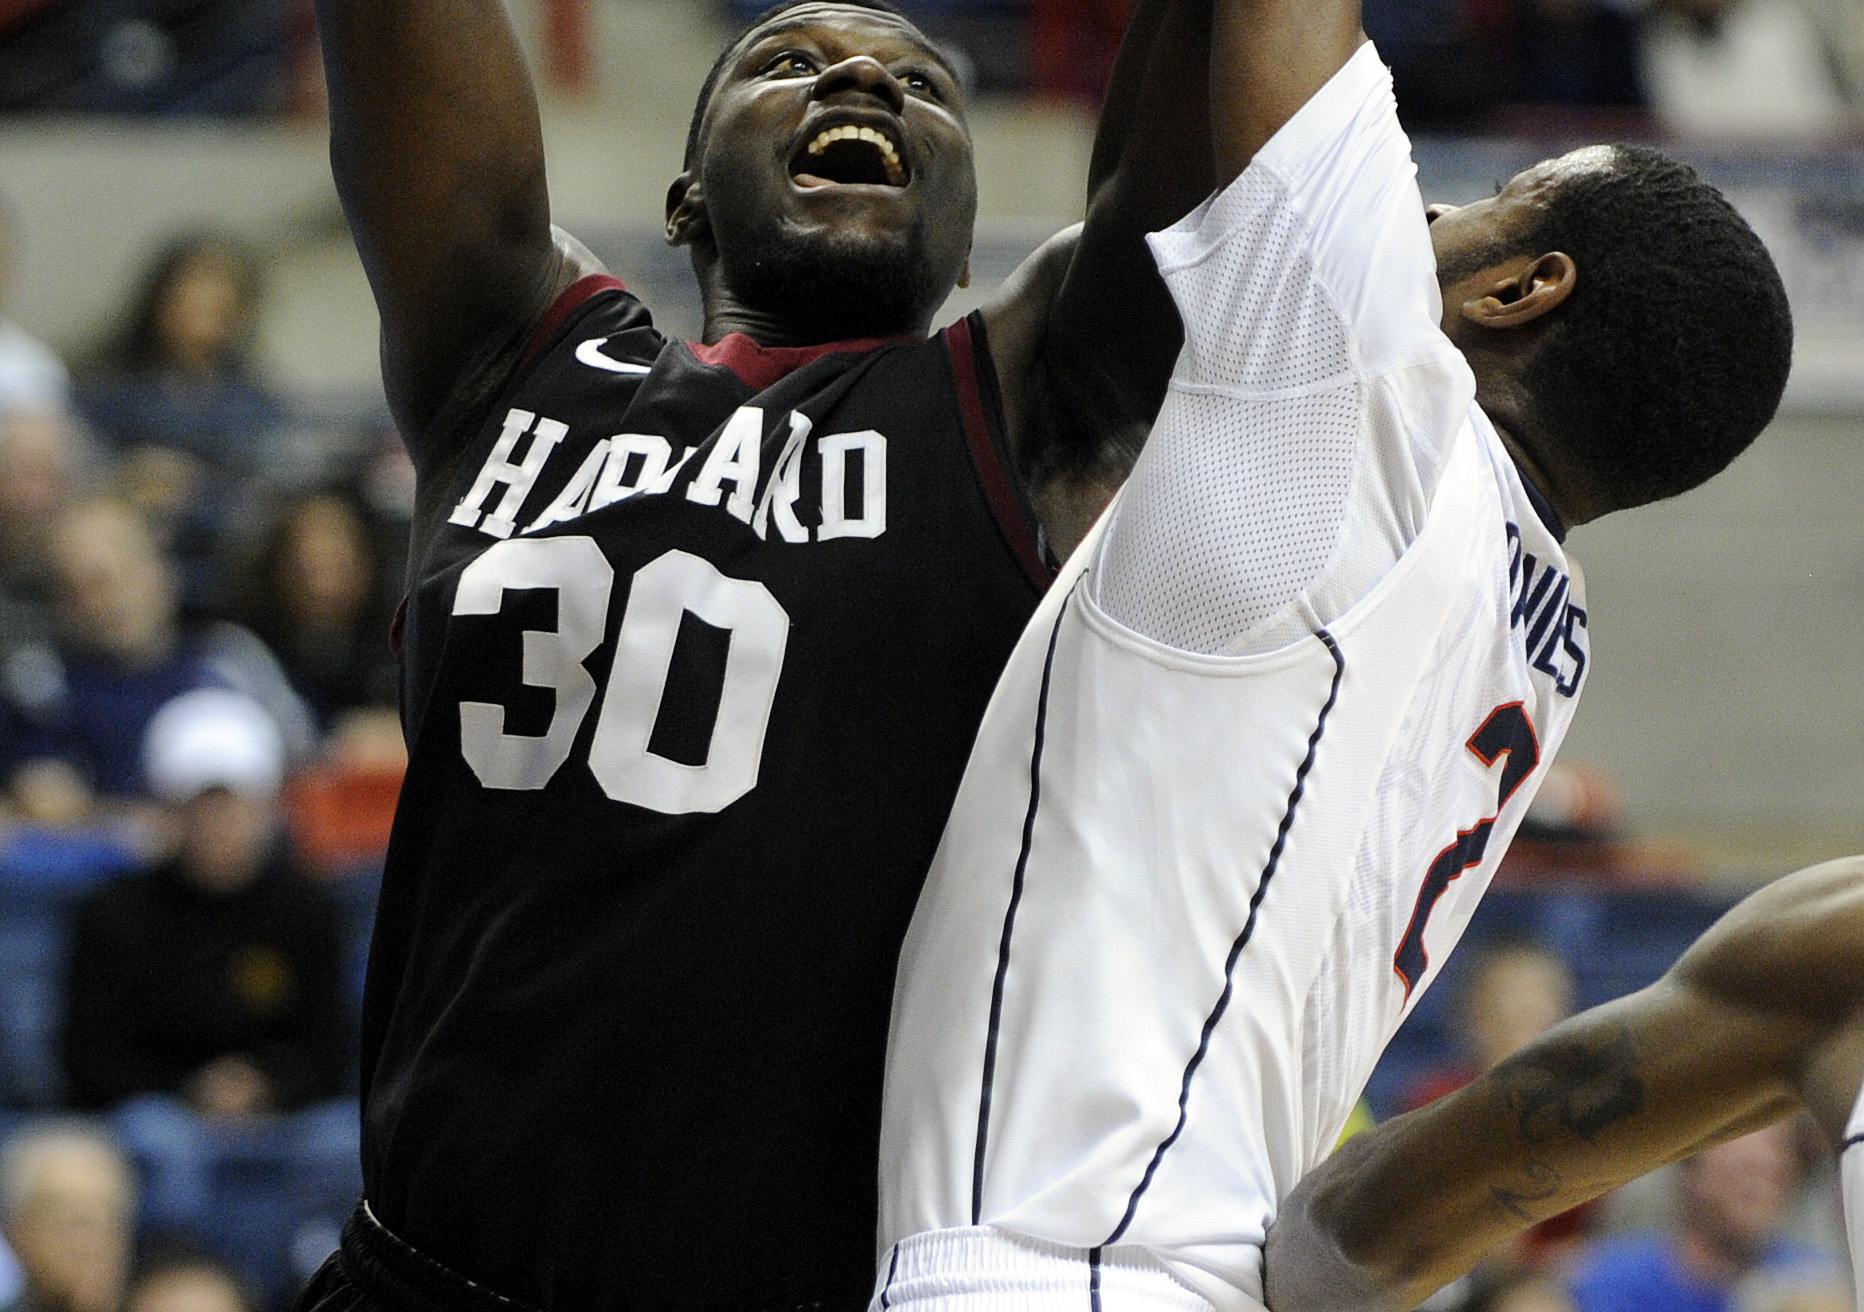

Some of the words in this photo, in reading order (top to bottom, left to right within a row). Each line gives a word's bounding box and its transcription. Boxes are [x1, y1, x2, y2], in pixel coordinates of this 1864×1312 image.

[447, 406, 888, 543] HARARD
[452, 536, 790, 815] 30
[1393, 700, 1540, 1014] 2
